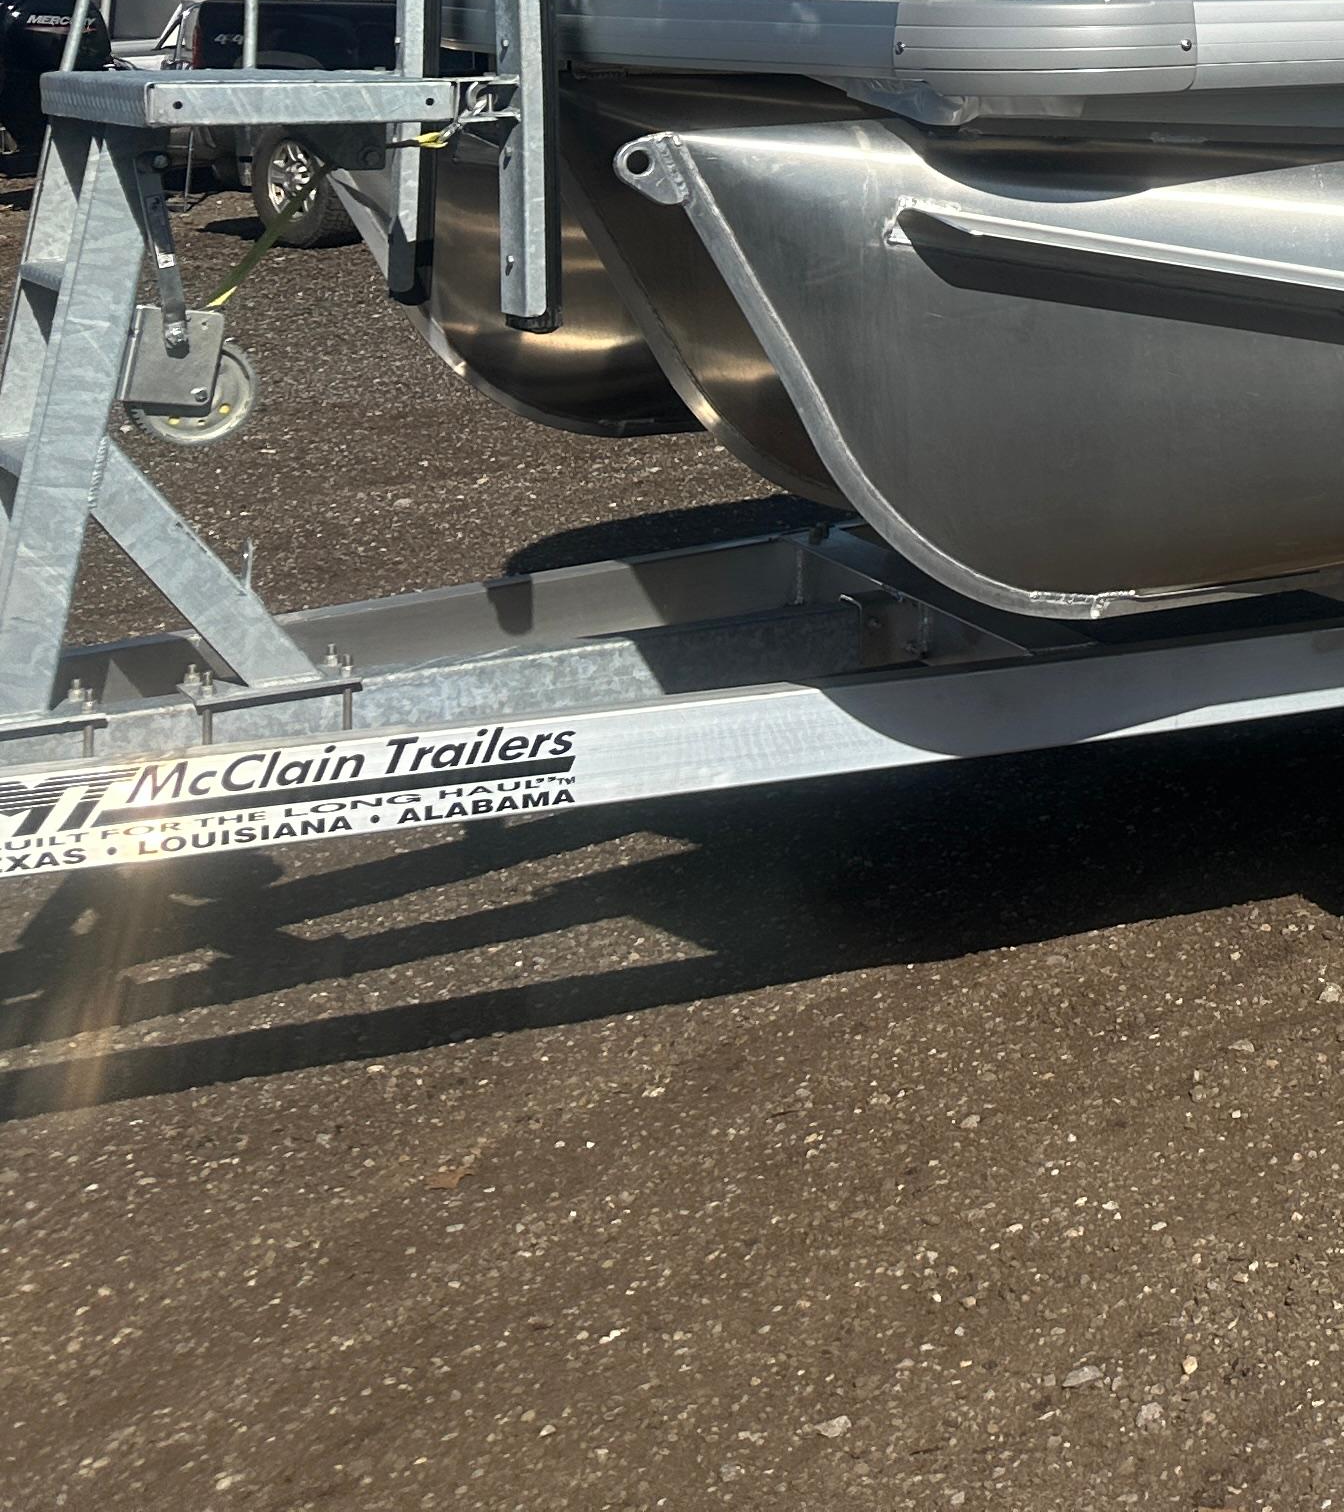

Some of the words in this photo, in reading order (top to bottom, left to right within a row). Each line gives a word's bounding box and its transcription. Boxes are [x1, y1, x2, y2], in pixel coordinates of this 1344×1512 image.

[26, 14, 96, 26] MERCY
[125, 744, 366, 804] McClain
[384, 726, 577, 775] Trailers
[0, 832, 89, 851] UILT
[101, 822, 182, 840] FOR
[194, 810, 266, 828] THE
[284, 793, 422, 818] LONG
[0, 847, 87, 874] XAS
[138, 815, 353, 855] LOUISIANA
[397, 788, 576, 825] ALABAMA
